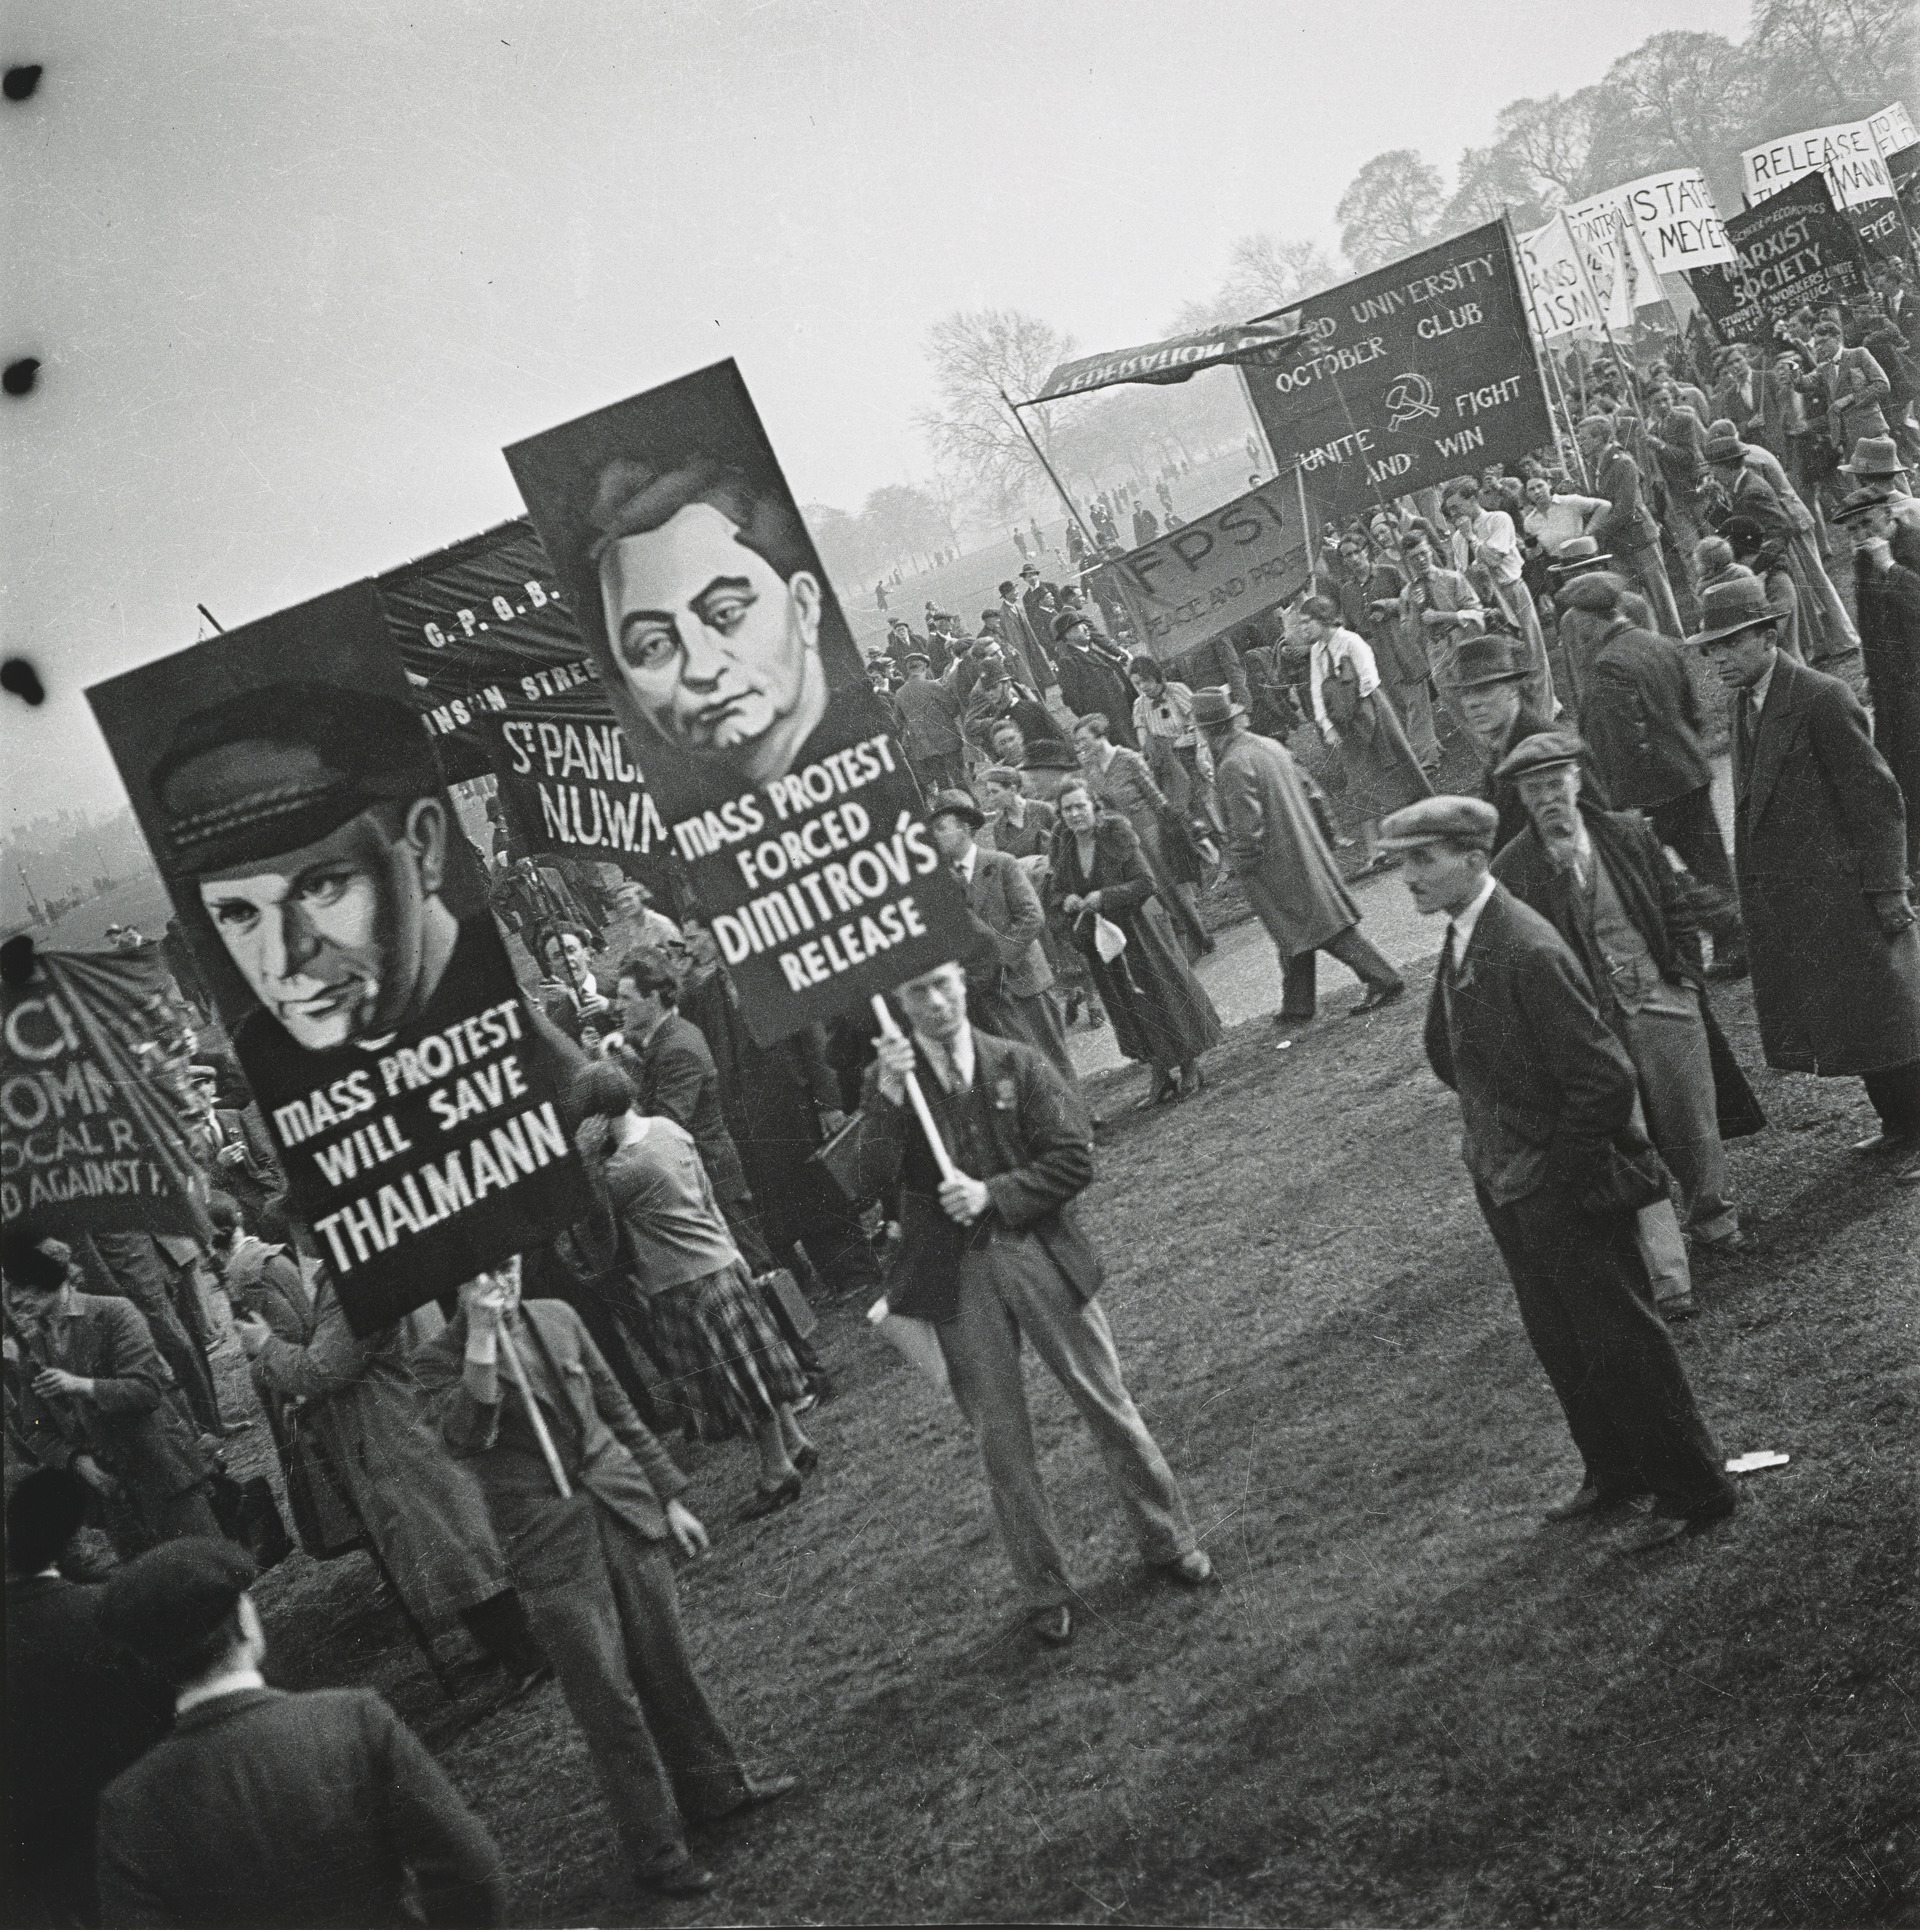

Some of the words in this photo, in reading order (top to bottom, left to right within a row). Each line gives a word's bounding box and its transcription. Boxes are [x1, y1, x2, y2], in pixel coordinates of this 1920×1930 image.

[1753, 132, 1869, 181] RELEASE
[1350, 257, 1494, 323] UNIVERSITY
[1734, 242, 1822, 306] SOCIETY
[1276, 337, 1387, 392] OCTOBER
[1417, 303, 1483, 339] CLUB
[1299, 429, 1374, 471] UNITE
[1455, 375, 1520, 417] FIGHT
[1367, 453, 1411, 485] AND
[1435, 426, 1484, 458] WIN
[673, 793, 764, 861] MASS
[767, 734, 895, 820] PROTEST
[712, 810, 938, 965] DIMITROV'S
[736, 802, 869, 889] FORCED
[779, 897, 926, 992] RELEASE
[273, 1069, 377, 1148] MASS
[379, 999, 522, 1097] PROTEST
[313, 1115, 412, 1186] WILL
[428, 1056, 528, 1130] SAVE
[30, 1160, 139, 1209] AGAINST
[314, 1101, 569, 1273] THALMANN
